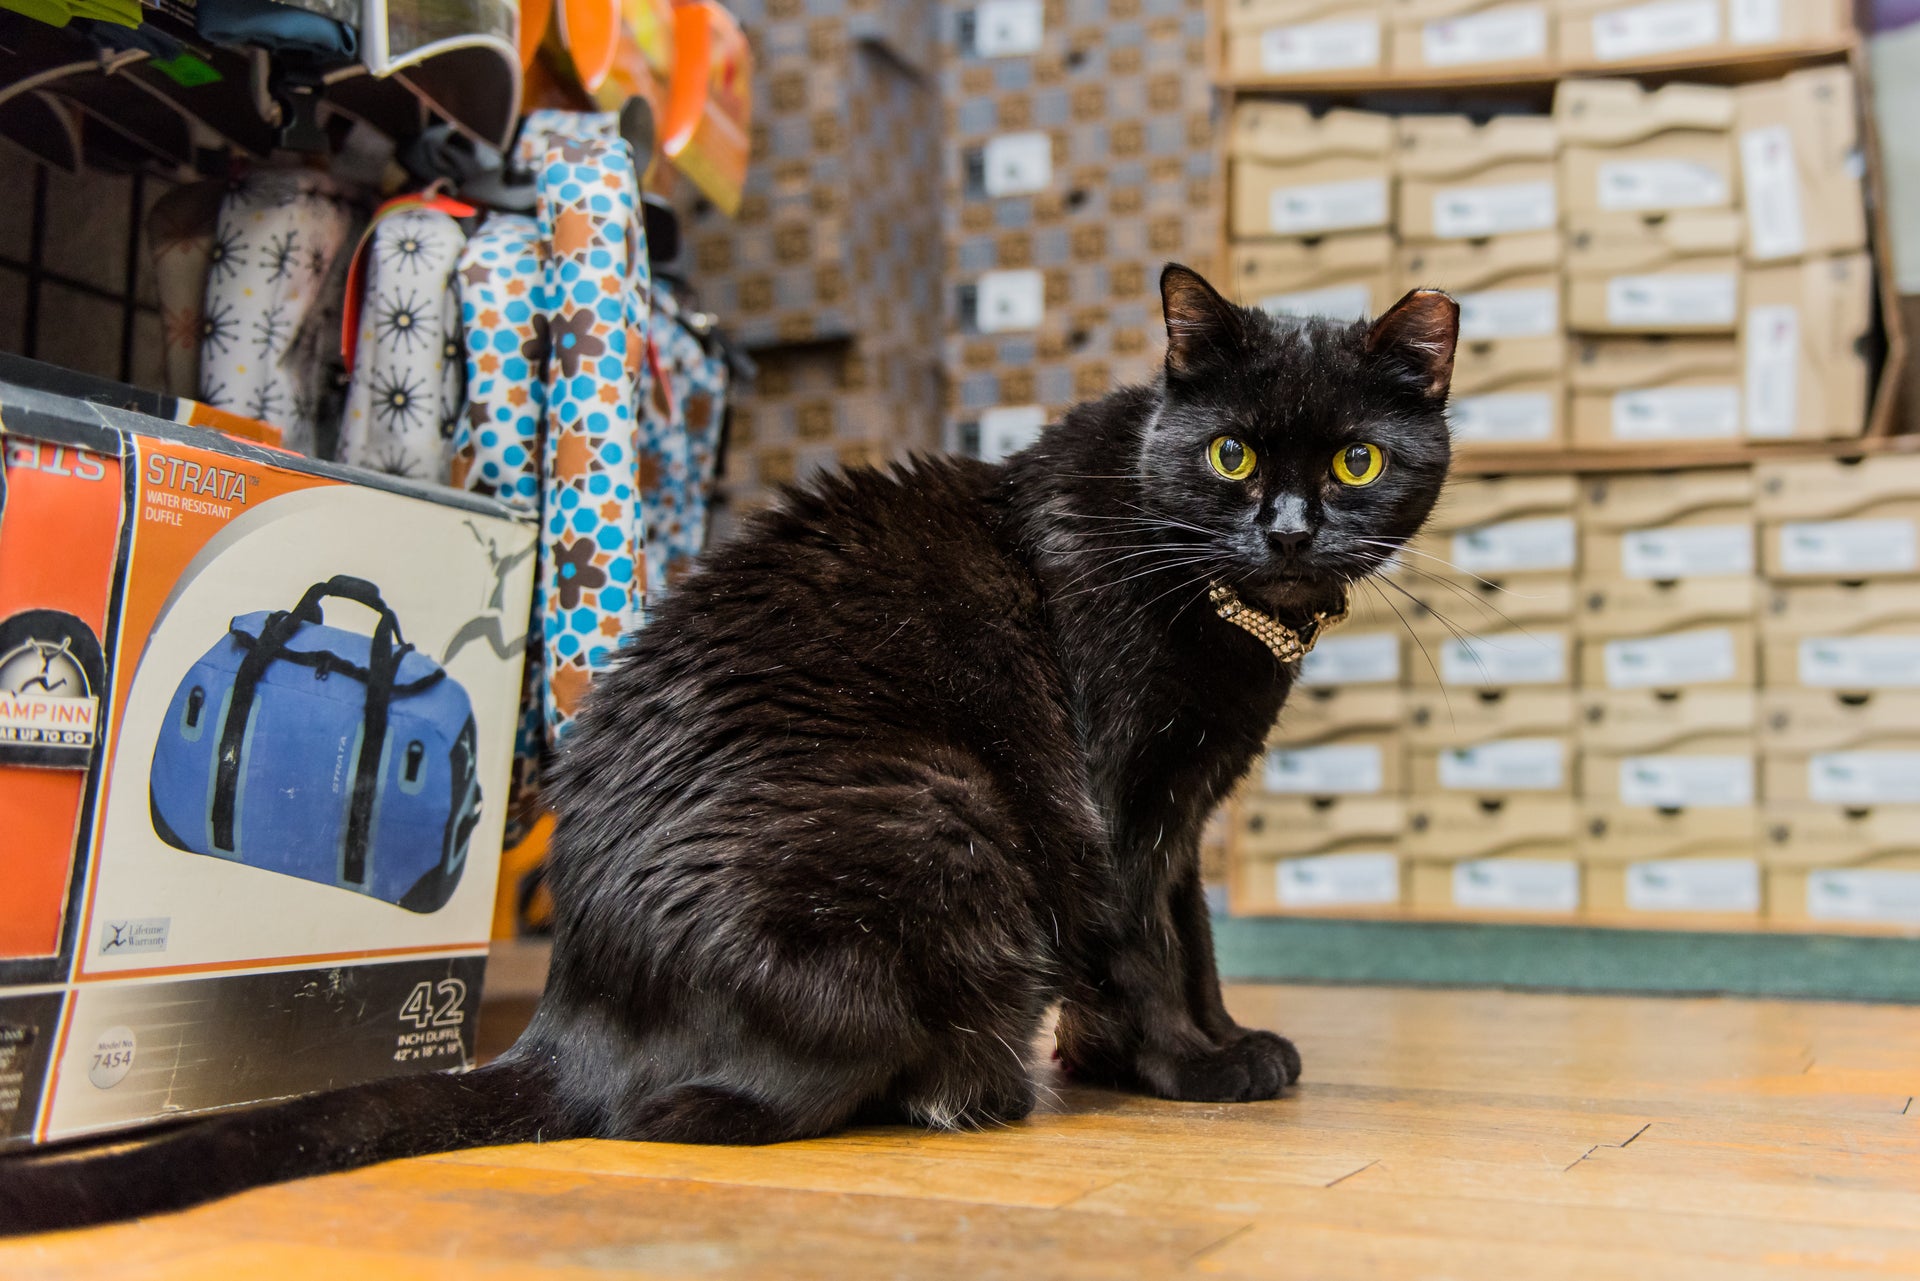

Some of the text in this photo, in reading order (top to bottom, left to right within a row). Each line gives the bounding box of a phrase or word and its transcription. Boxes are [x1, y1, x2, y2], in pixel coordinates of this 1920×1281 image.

[147, 453, 246, 504] STRATA
[146, 490, 233, 519] WATER RESISTANT
[145, 507, 183, 526] DUFFLE
[50, 703, 91, 724] INN
[20, 728, 40, 741] UP
[42, 730, 60, 743] TO
[63, 731, 86, 744] GO
[332, 736, 347, 793] STRATA
[128, 935, 166, 947] Warranty
[399, 978, 467, 1028] 42
[98, 1040, 121, 1050] Model
[398, 1031, 424, 1046] INCH
[93, 1050, 131, 1070] 7454
